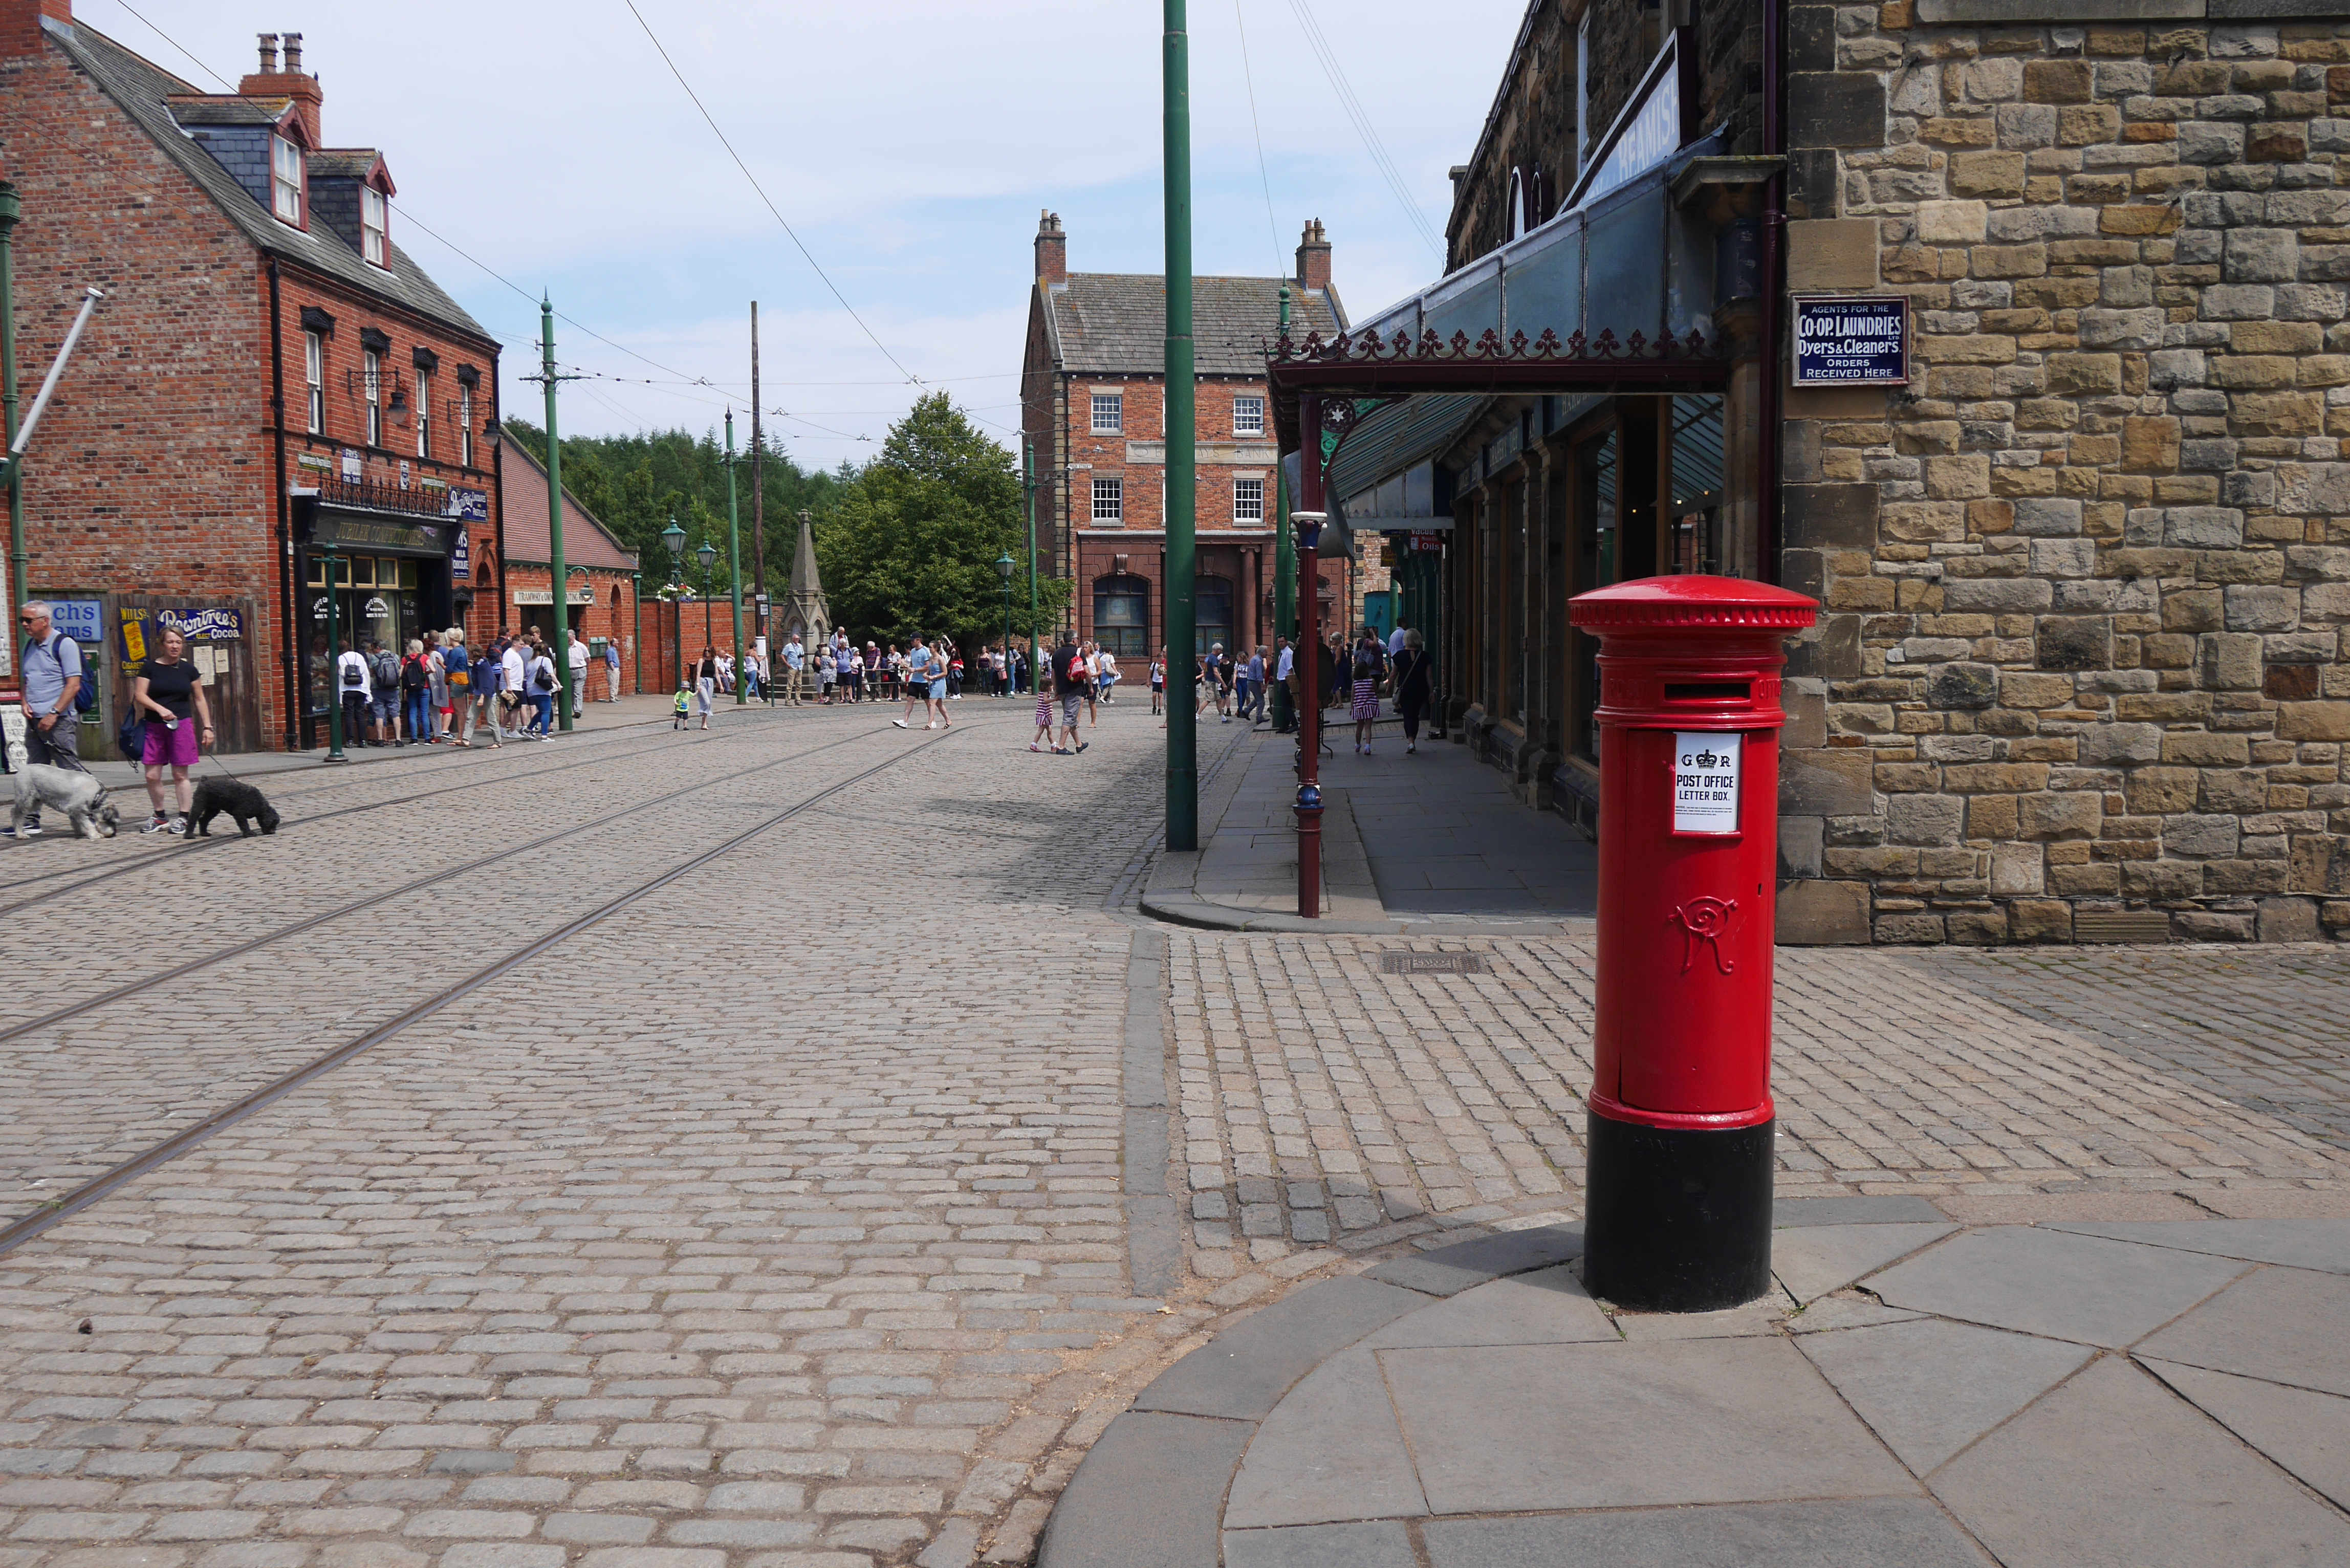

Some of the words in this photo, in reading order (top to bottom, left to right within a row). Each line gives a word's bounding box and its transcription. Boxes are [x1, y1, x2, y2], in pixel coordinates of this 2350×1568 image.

[1836, 316, 1902, 337] LAUNDRIES
[1798, 339, 1835, 356] Dyers
[1836, 344, 1843, 354] &
[1844, 339, 1901, 354] Cleaners.
[1807, 368, 1861, 378] RECEIVED
[1865, 368, 1893, 377] HERE
[1236, 448, 1270, 459] BANK
[1422, 542, 1440, 551] Oils
[518, 592, 541, 602] TRAMWAY
[1682, 754, 1692, 767] G
[1677, 775, 1702, 788] POST
[1704, 776, 1734, 788] OFFICE
[1679, 791, 1710, 800] LETTER
